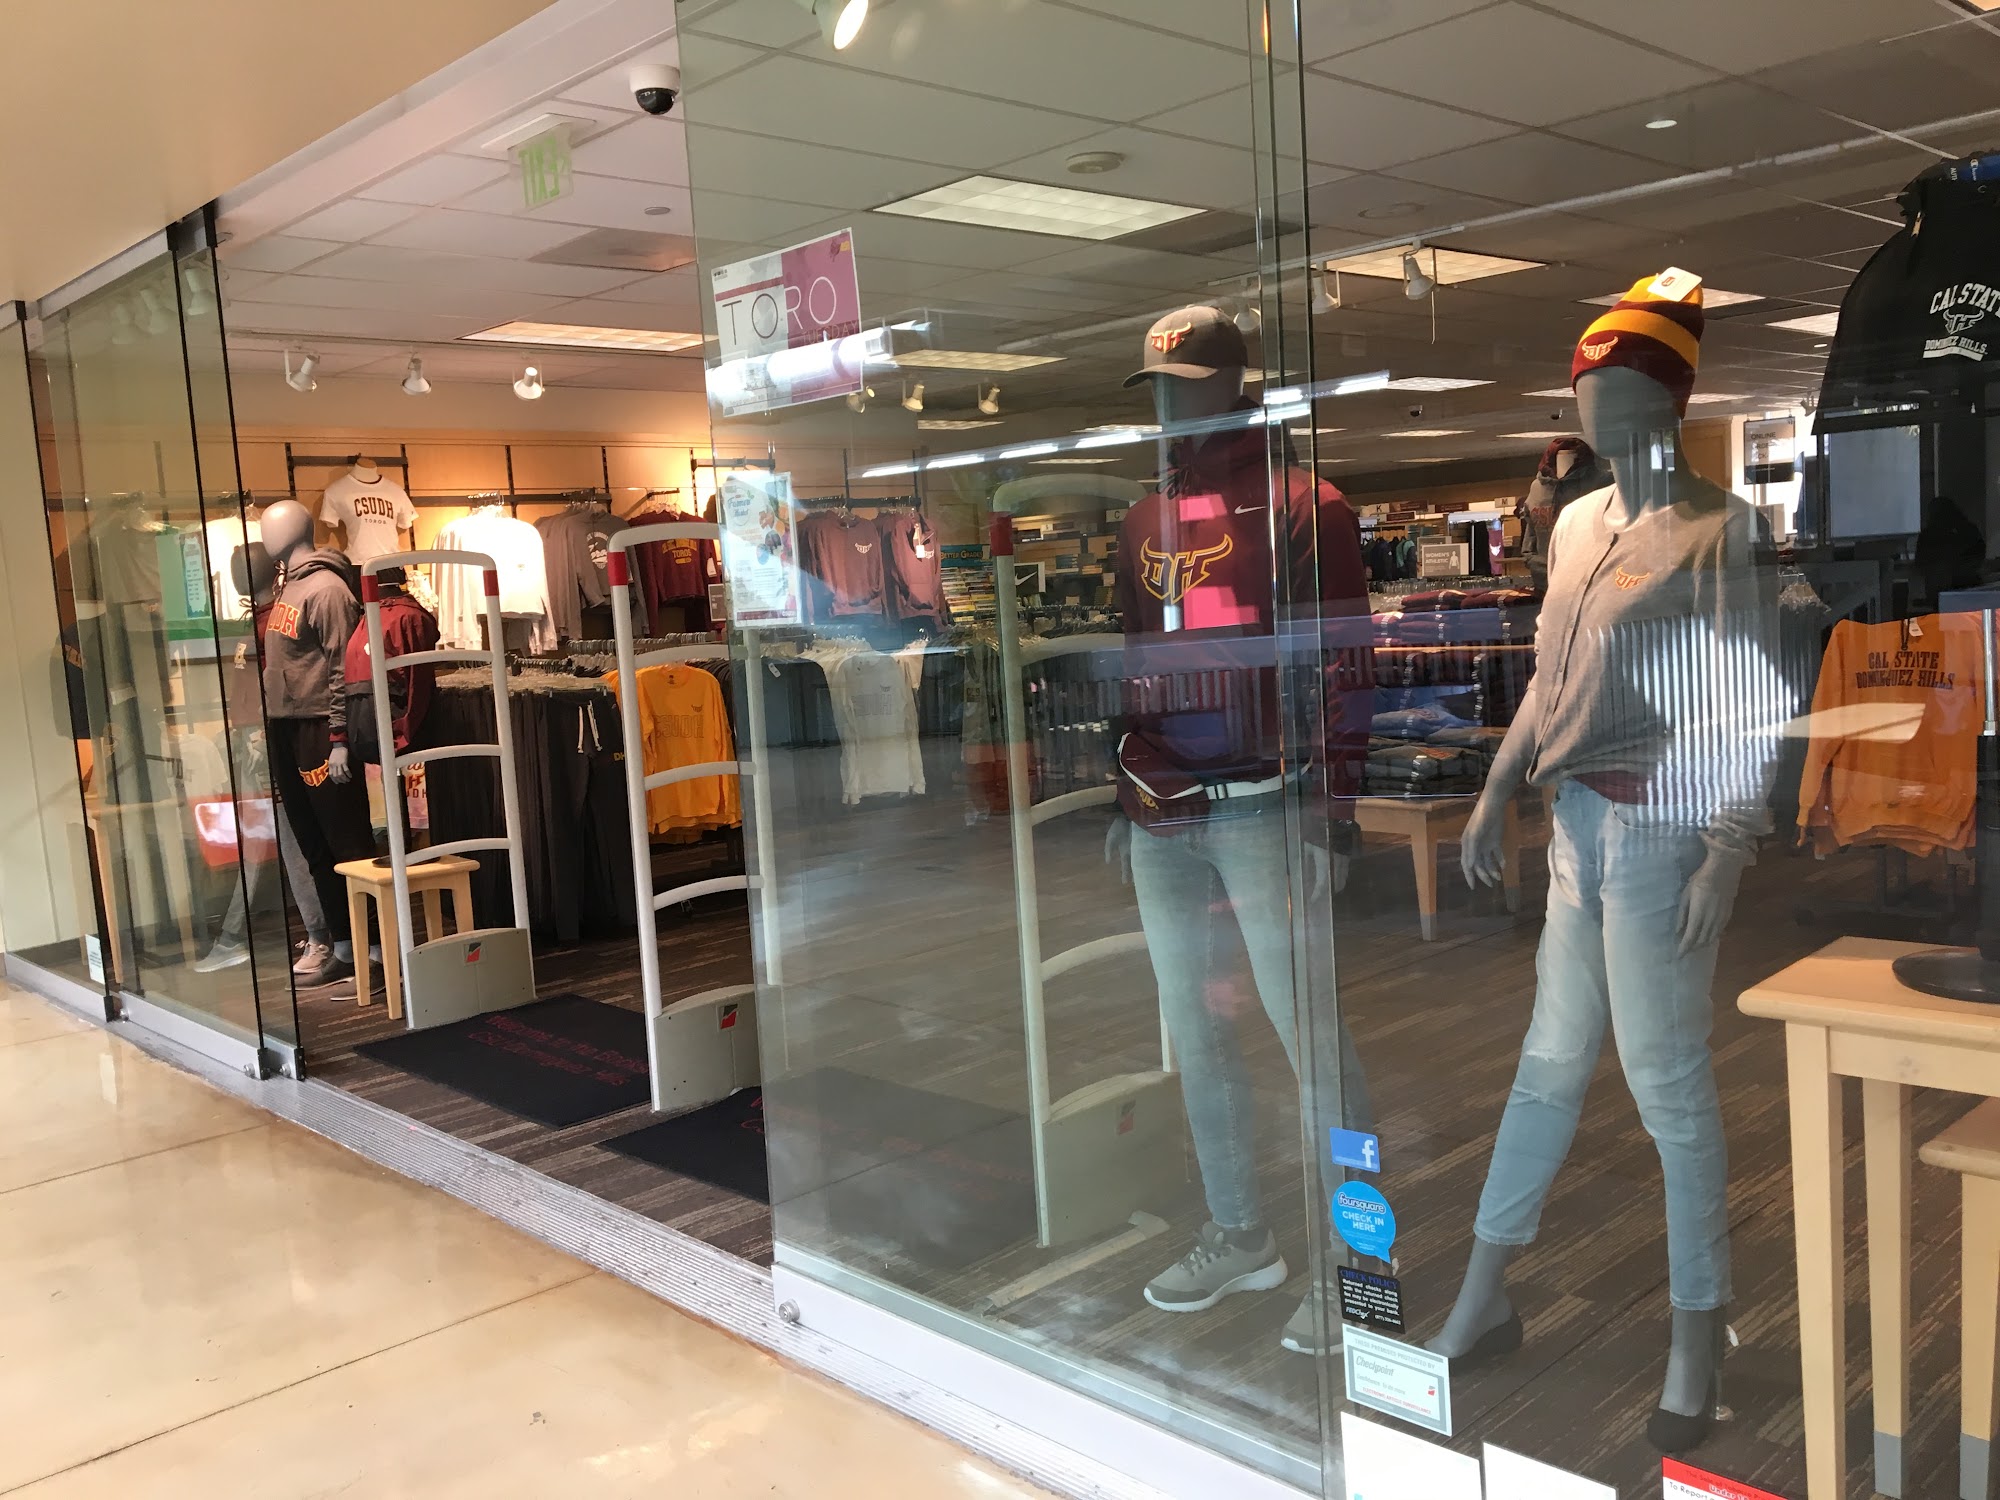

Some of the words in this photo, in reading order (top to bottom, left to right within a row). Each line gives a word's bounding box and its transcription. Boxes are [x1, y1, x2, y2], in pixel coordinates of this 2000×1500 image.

[1930, 285, 1959, 315] CAL
[721, 275, 837, 346] TORO
[1958, 337, 1987, 354] HILLS
[1751, 432, 1776, 440] ONLINE
[354, 497, 394, 520] CSUDH
[1868, 652, 1889, 670] CAL
[1894, 651, 1940, 669] STATE
[1917, 670, 1955, 690] HILLS
[1338, 1192, 1386, 1214] foursquare
[1342, 1211, 1372, 1223] CHECK
[1374, 1216, 1384, 1226] IN
[1352, 1221, 1376, 1233] HERE
[1340, 1269, 1366, 1282] CHECK
[1369, 1276, 1397, 1289] POLICY
[1355, 1338, 1371, 1348] THESE
[1371, 1343, 1397, 1357] PREMISES
[1398, 1351, 1427, 1366] PROTECTED
[1428, 1361, 1435, 1369] BY
[1356, 1355, 1394, 1377] Checkpoint
[1669, 1481, 1678, 1490] To
[1680, 1484, 1708, 1499] Report
[1709, 1484, 1736, 1500] Under
